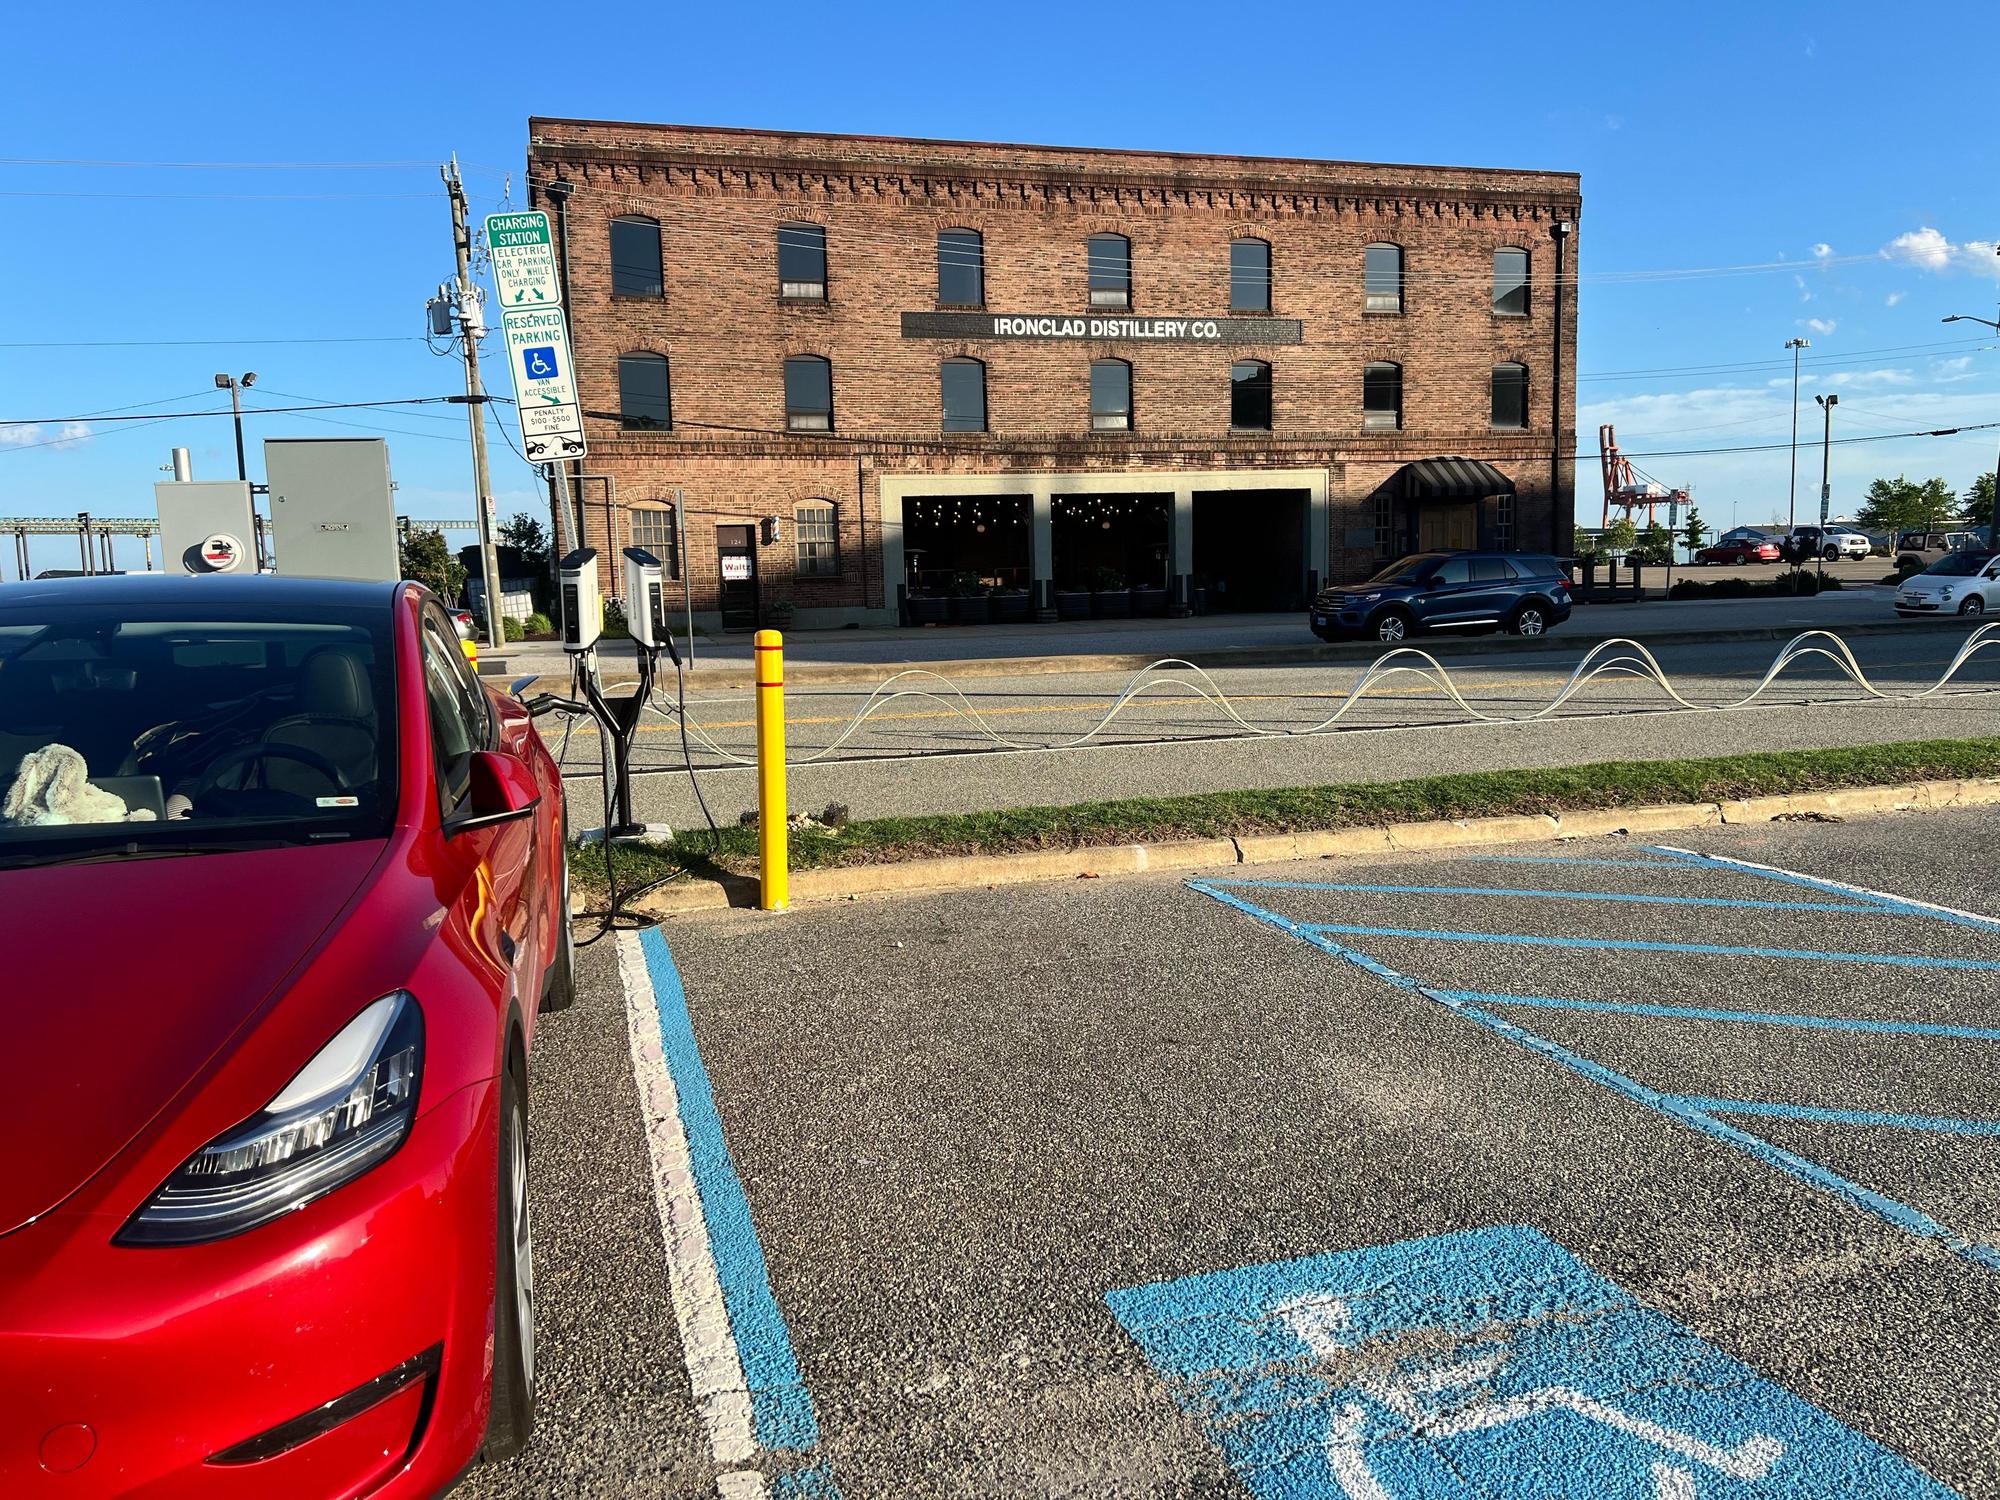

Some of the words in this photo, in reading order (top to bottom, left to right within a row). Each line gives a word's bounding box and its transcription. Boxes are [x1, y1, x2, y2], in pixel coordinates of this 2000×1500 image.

[490, 215, 544, 231] CHARGING
[499, 231, 541, 246] STATION
[497, 245, 547, 258] ELECTRIC
[496, 259, 513, 270] CAR
[517, 256, 551, 267] PARKING
[501, 269, 520, 279] ONLY
[527, 266, 550, 276] WHILE
[508, 276, 546, 288] CHARGING
[506, 314, 561, 330] RESERVED
[994, 318, 1086, 336] IRONCLAD
[1090, 319, 1188, 338] DISTILLERY
[1191, 321, 1221, 338] CO.
[512, 329, 561, 345] PARKING
[536, 378, 551, 386] VAN
[524, 385, 567, 397] ACCESSIBLE
[533, 408, 565, 417] PENALTY
